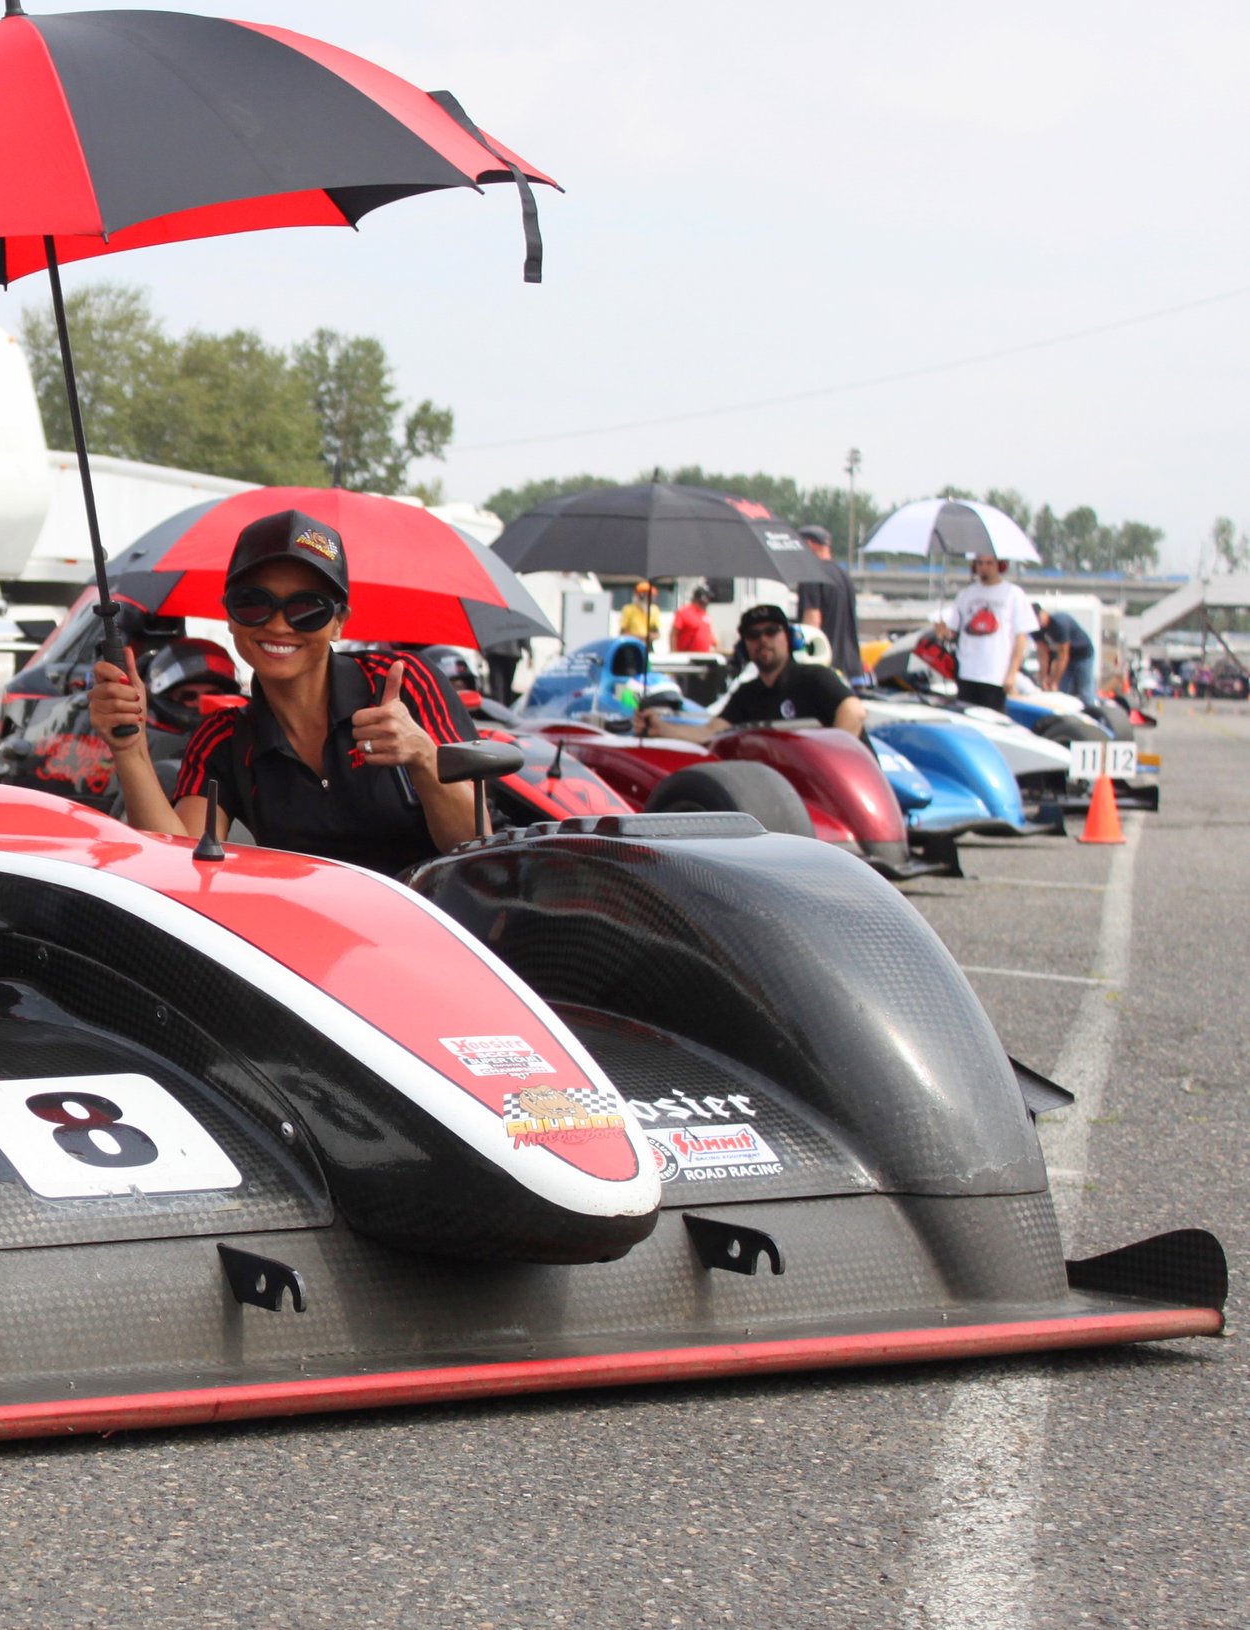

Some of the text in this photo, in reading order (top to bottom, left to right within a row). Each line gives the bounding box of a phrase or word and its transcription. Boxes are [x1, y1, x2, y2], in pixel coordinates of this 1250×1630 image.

[1081, 748, 1097, 771] 11
[1112, 748, 1134, 771] 12
[626, 1089, 757, 1122] osier
[683, 1163, 784, 1182] ROAD RACING
